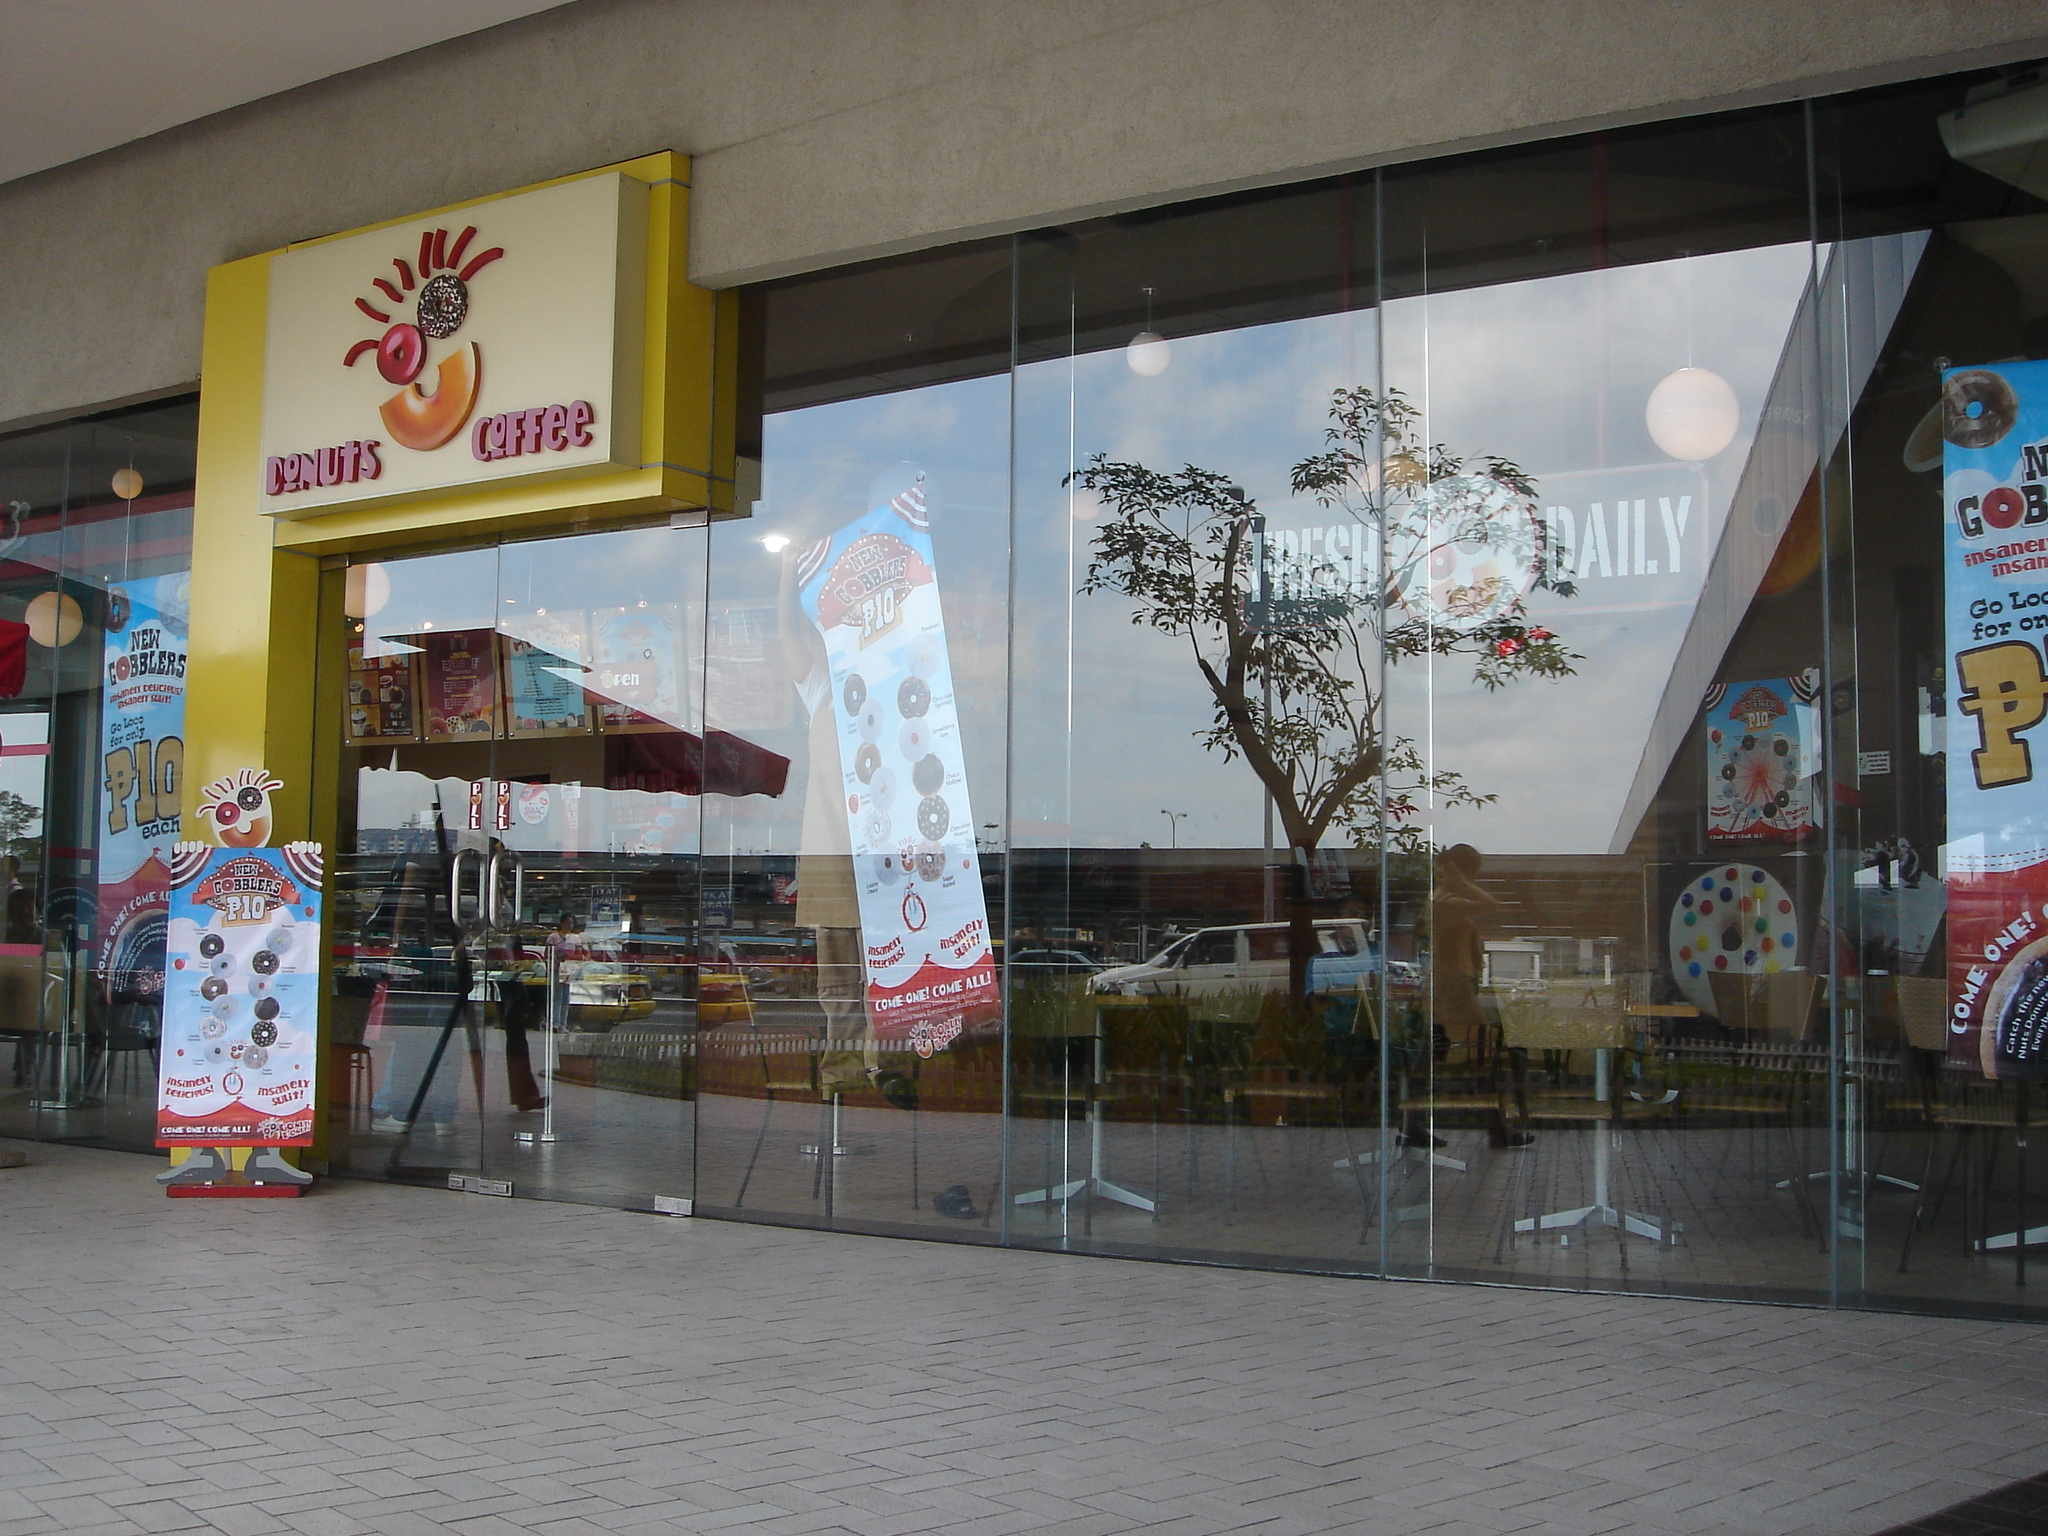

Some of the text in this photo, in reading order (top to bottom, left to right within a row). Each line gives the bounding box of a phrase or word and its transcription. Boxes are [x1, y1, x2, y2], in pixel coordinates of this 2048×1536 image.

[1546, 496, 1692, 583] DAILY
[1970, 599, 2003, 619] Go
[130, 629, 161, 652] NEW
[1972, 621, 2012, 641] for
[108, 651, 187, 686] GOBBLERS
[111, 716, 144, 735] Go Loco
[110, 735, 124, 748] for
[142, 818, 181, 839] each
[235, 864, 258, 876] NEW
[213, 878, 282, 895] GOBBLERS
[129, 891, 157, 911] COME
[1951, 911, 2037, 1034] COME ONE!
[875, 994, 904, 1012] COME
[905, 985, 931, 1004] ONE!
[932, 979, 963, 997] COME
[965, 971, 992, 990] ALL!
[2006, 1018, 2022, 1054] Catch
[2018, 993, 2034, 1014] the
[2018, 1031, 2030, 1060] Nuts
[161, 1125, 251, 1134] COME ONE! COME ALL!
